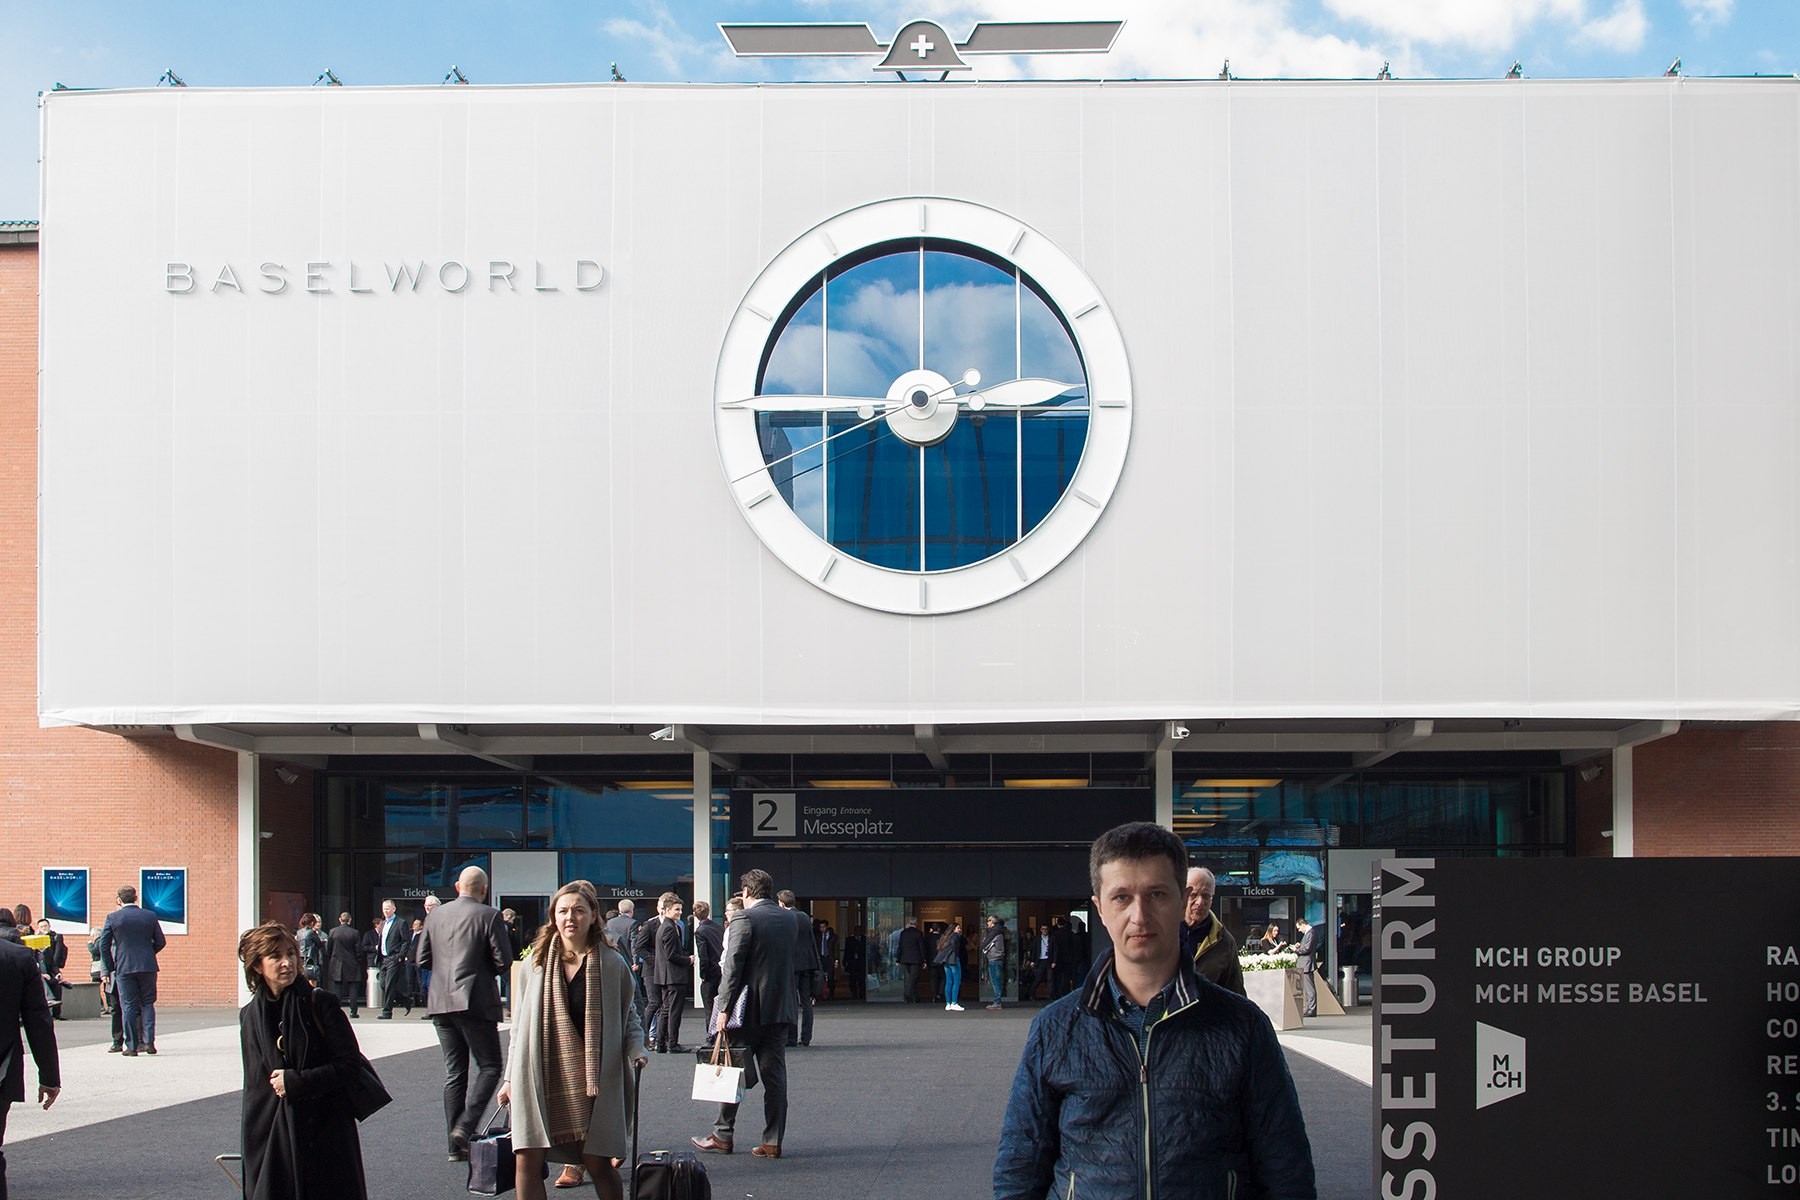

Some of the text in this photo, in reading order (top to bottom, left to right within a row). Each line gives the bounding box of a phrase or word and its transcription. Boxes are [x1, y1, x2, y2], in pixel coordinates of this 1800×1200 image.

[165, 259, 606, 293] BASELWORLD
[757, 799, 778, 832] 2
[803, 805, 872, 817] Eingang Entrance
[803, 818, 894, 839] Messeplatz
[402, 888, 435, 897] Tickets
[611, 888, 644, 897] Tickets
[1242, 886, 1275, 896] Tickets
[1475, 946, 1622, 967] MCH GROUP
[1766, 945, 1800, 966] RA
[1475, 982, 1708, 1004] MCH MESSE BASEL
[1766, 982, 1800, 1002] HO
[1766, 1018, 1798, 1039] CO
[1493, 1054, 1510, 1071] M
[1767, 1055, 1798, 1075] RE
[1766, 1091, 1787, 1111] 3.
[1767, 1164, 1800, 1184] LO
